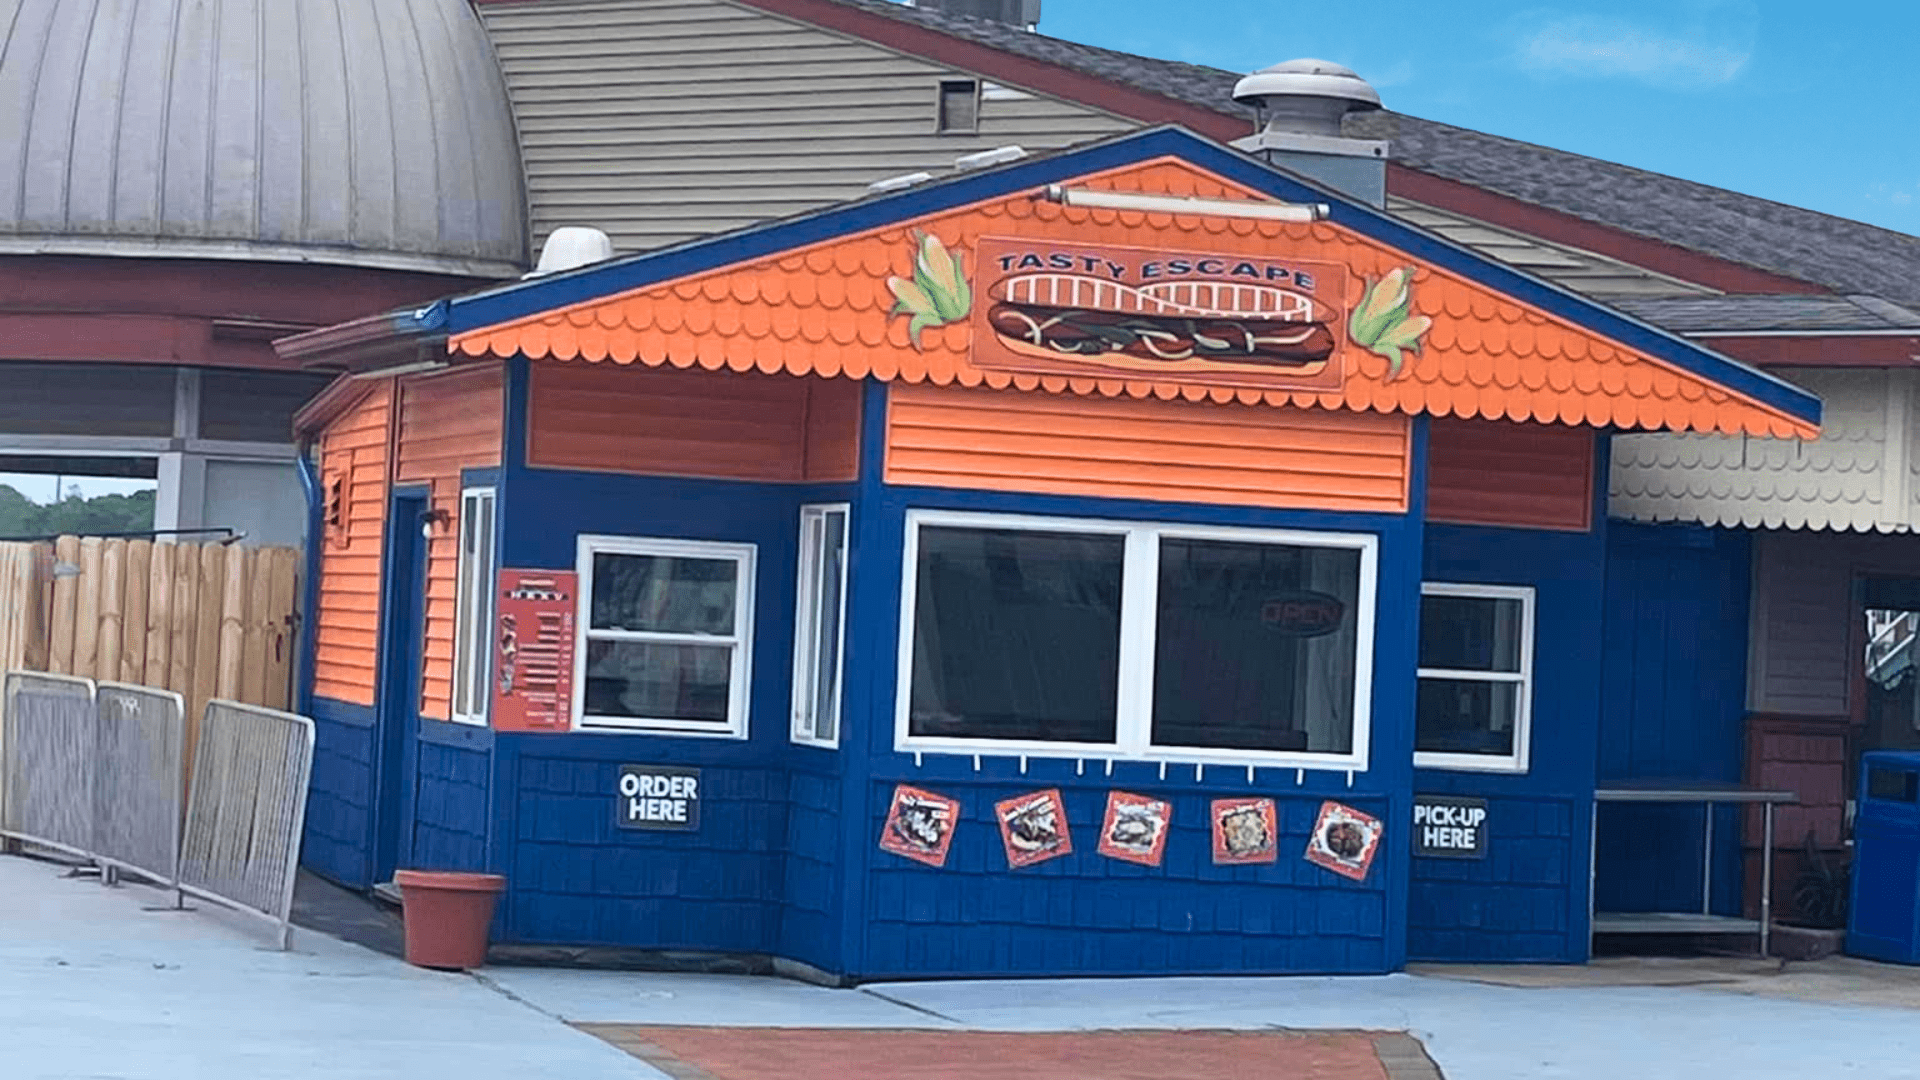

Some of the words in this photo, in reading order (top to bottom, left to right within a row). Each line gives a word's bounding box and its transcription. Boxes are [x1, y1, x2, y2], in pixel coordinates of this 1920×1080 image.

[999, 253, 1125, 279] TASTY
[1141, 259, 1316, 288] ESCAPE
[1261, 602, 1340, 624] OPEN
[620, 773, 697, 799] ORDER
[629, 798, 687, 822] HERE
[1414, 805, 1486, 827] PICK-UP
[1424, 826, 1475, 849] HERE
